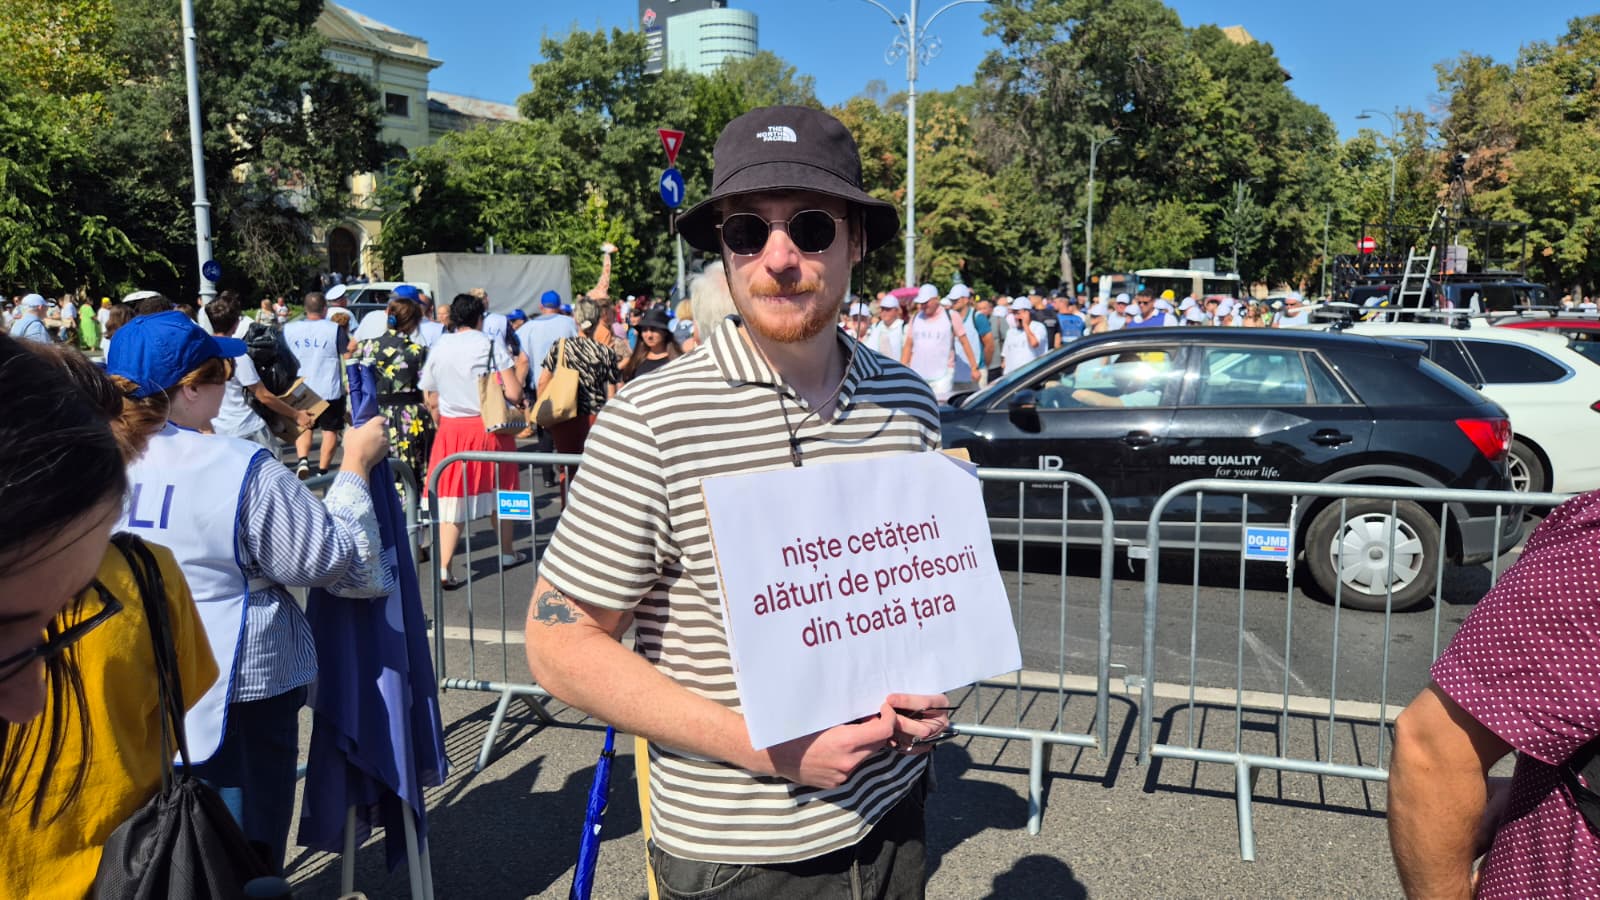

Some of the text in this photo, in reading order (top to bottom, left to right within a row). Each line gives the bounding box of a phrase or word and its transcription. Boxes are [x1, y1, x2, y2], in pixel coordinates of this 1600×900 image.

[1169, 455, 1262, 465] MORE QUALITY
[1215, 466, 1280, 479] for your life.
[782, 515, 940, 571] niște cetățeni
[1248, 535, 1288, 546] DGJMB
[753, 545, 978, 615] alături de profesorii
[802, 594, 956, 647] din toată țara
